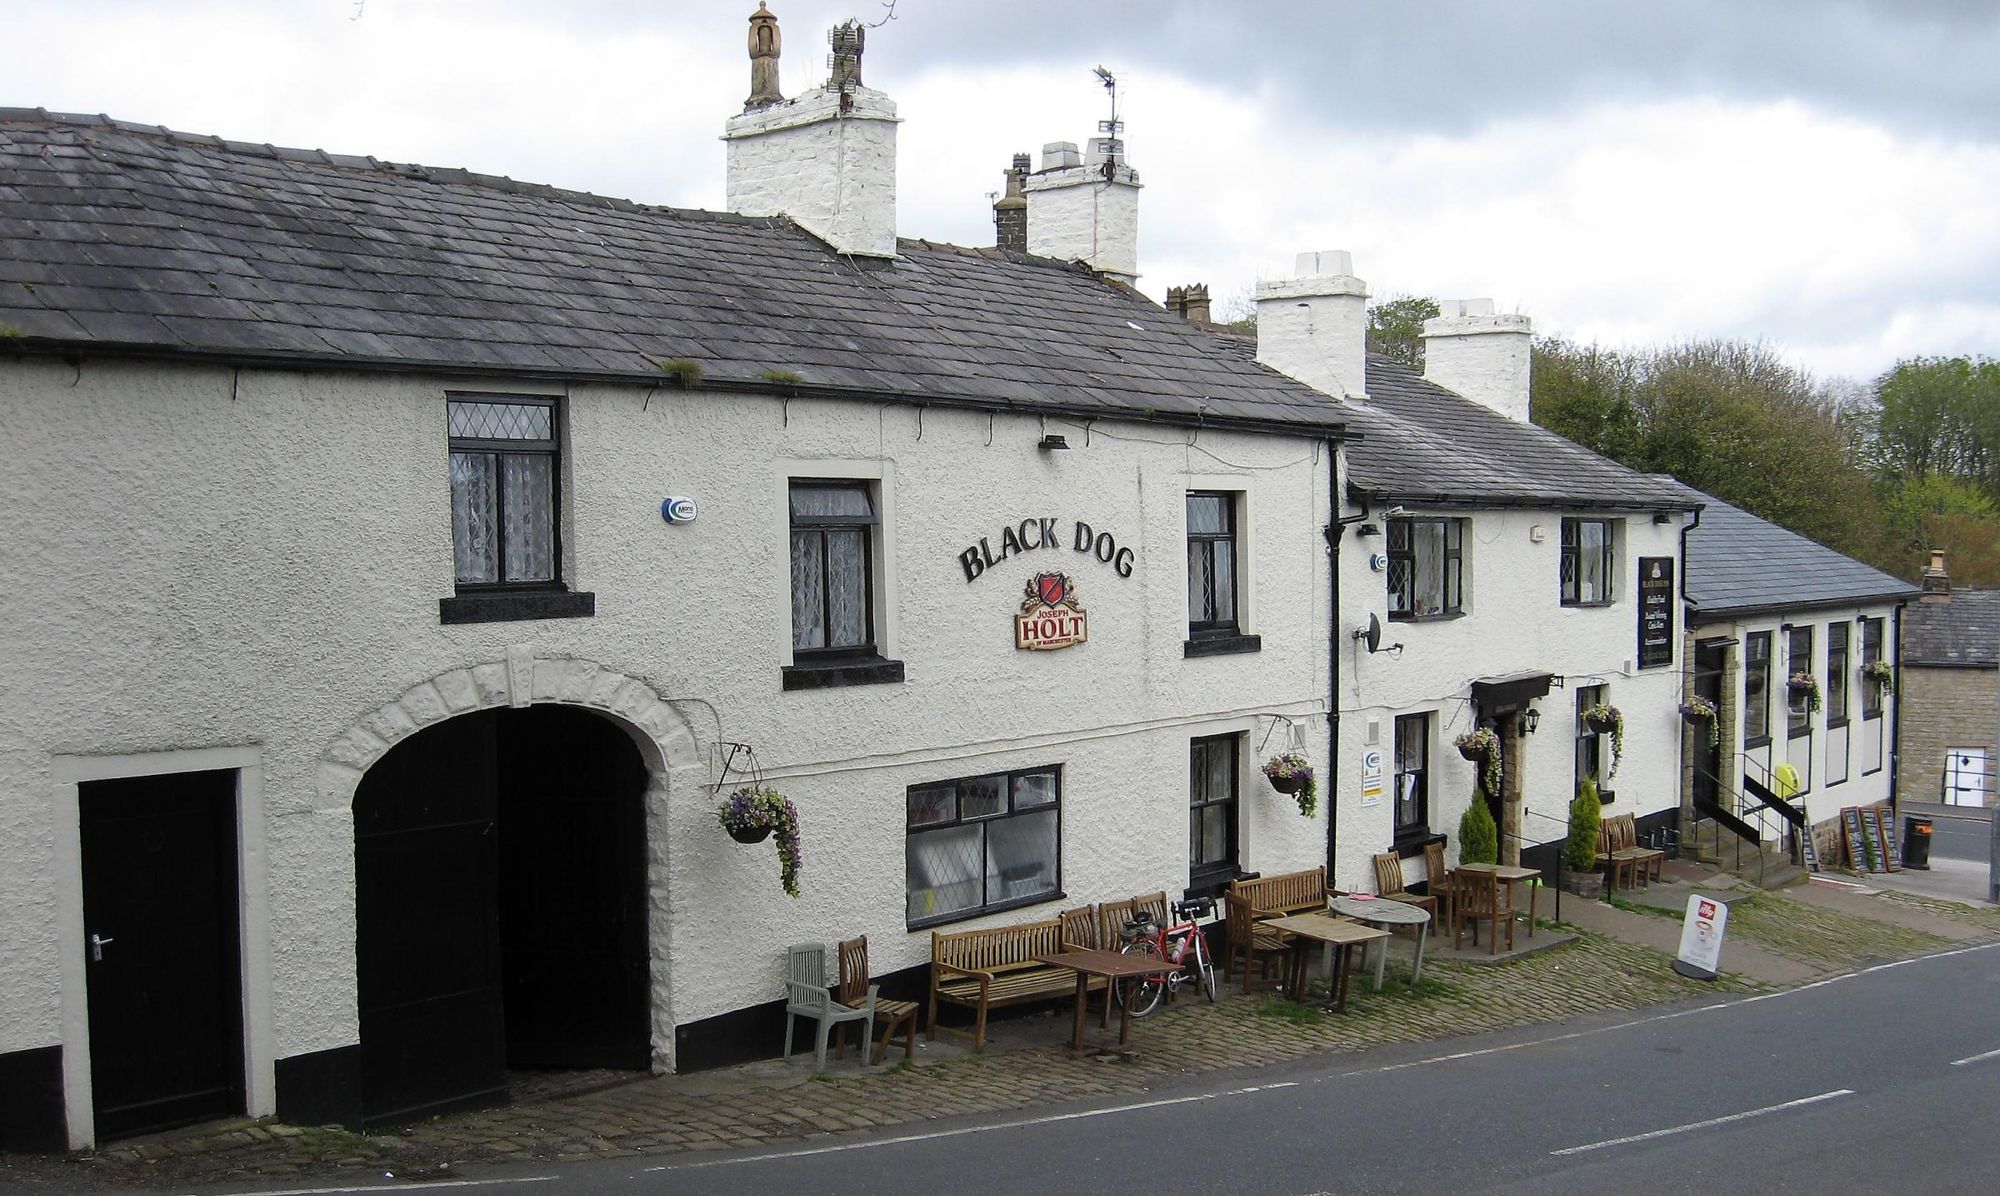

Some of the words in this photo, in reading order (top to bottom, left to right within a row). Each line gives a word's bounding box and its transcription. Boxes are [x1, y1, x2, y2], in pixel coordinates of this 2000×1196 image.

[959, 518, 1060, 583] BLACK
[1074, 521, 1135, 578] DOG
[1037, 610, 1069, 619] JOSEPH
[1023, 617, 1084, 640] HOLT
[1699, 903, 1714, 918] illy
